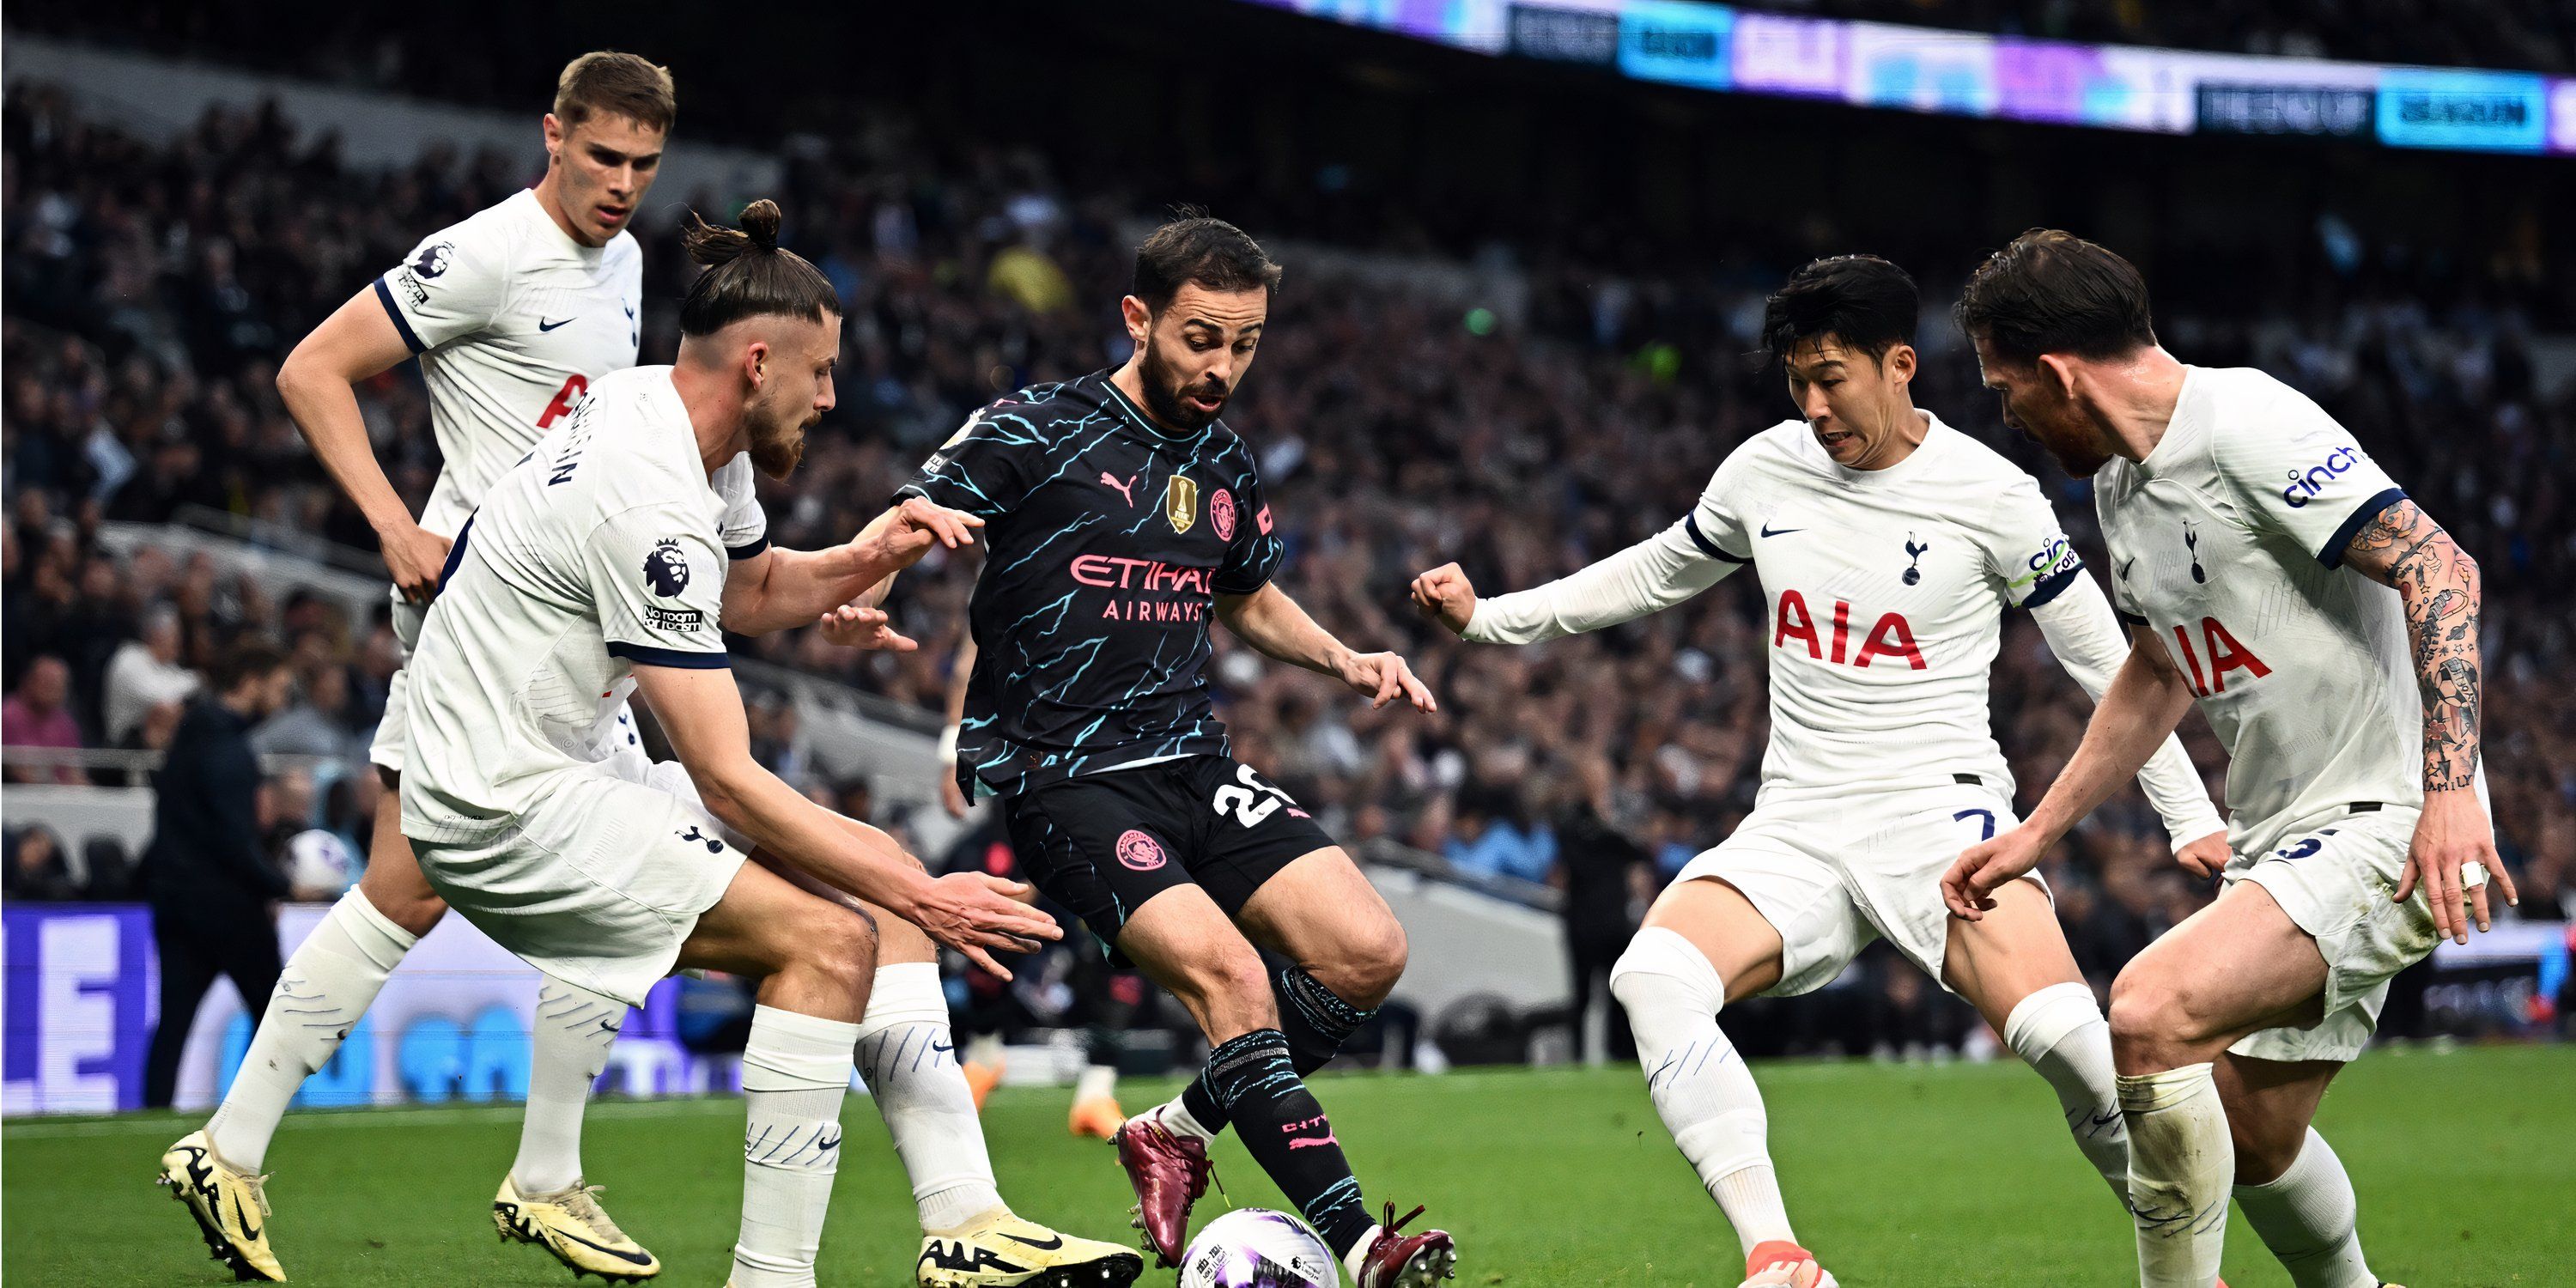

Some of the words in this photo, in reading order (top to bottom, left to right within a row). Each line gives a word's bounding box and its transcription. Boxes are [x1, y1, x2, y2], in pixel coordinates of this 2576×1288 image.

[2284, 447, 2366, 507] cinch
[644, 605, 661, 618] No
[662, 612, 697, 623] room
[1102, 599, 1203, 622] AIRWAYS
[1775, 589, 1928, 670] AIA
[2172, 616, 2273, 697] IA
[1952, 808, 1996, 841] 7
[1282, 1113, 1327, 1133] CITY
